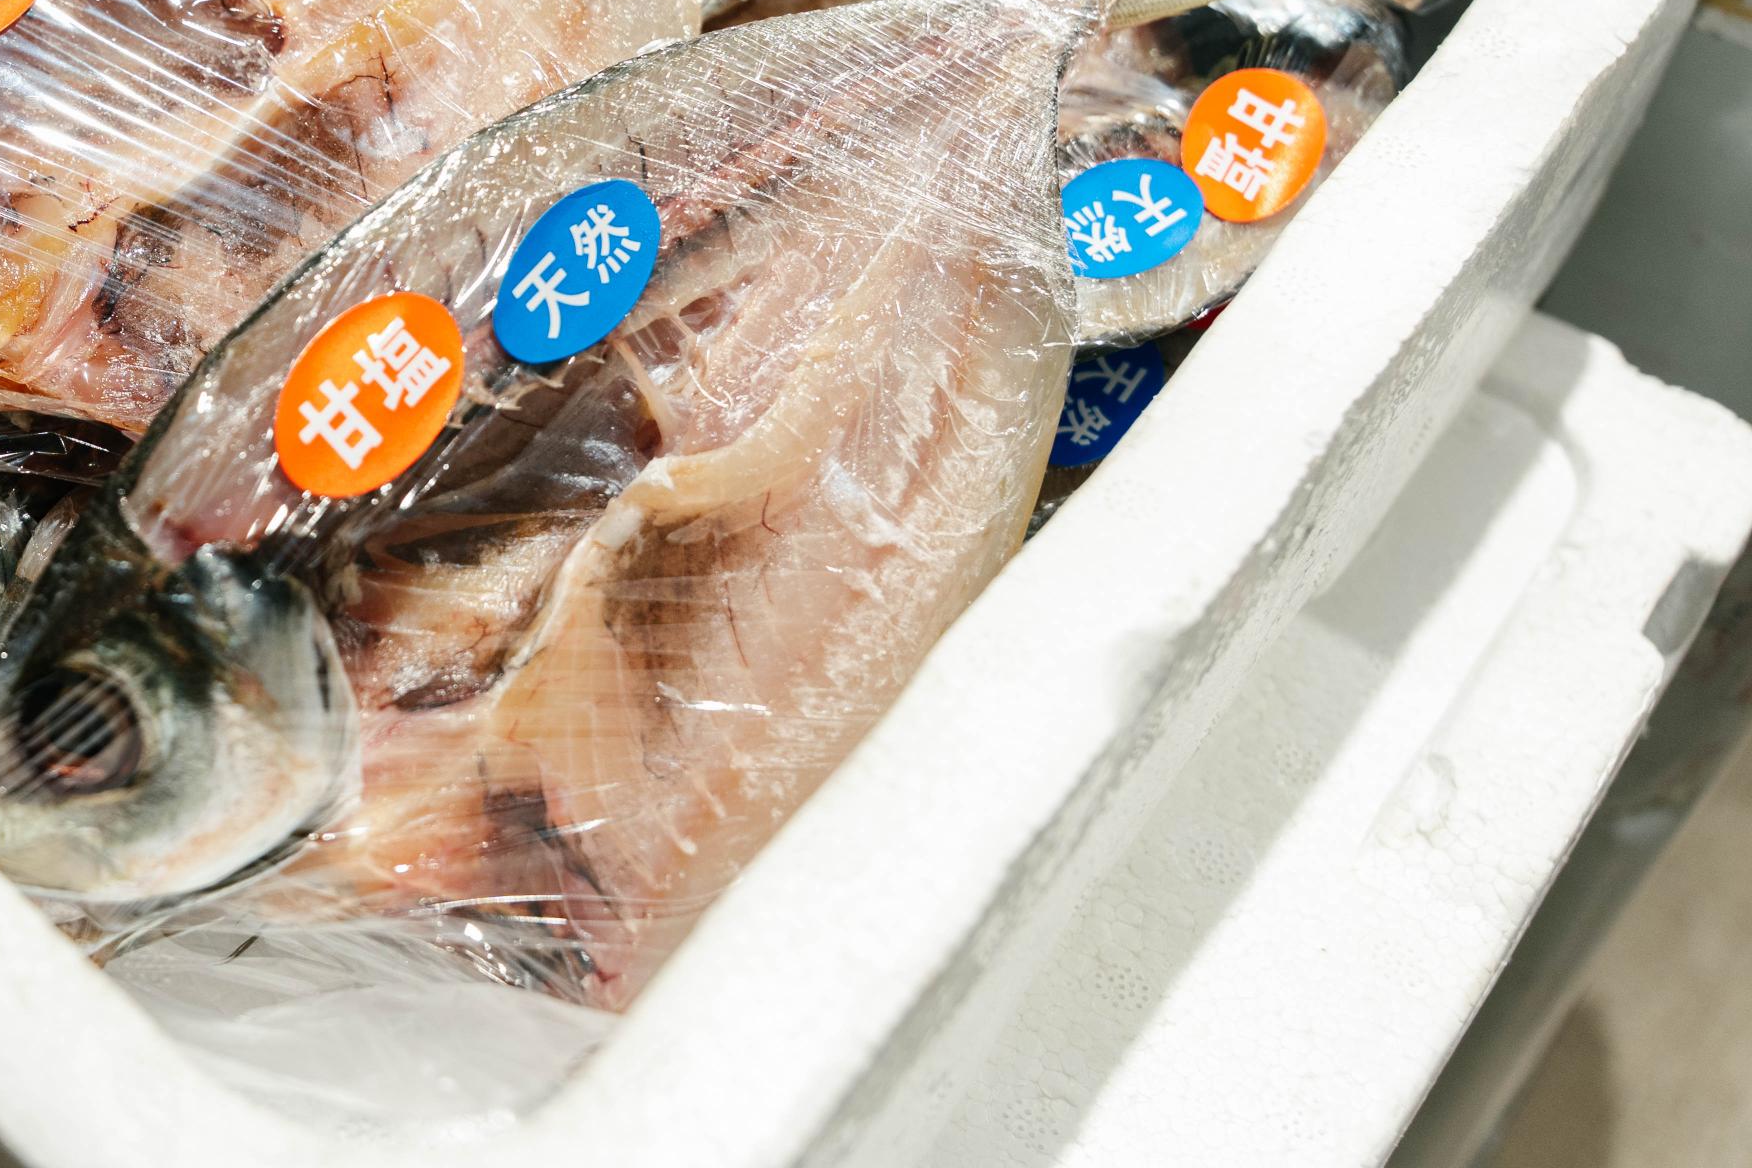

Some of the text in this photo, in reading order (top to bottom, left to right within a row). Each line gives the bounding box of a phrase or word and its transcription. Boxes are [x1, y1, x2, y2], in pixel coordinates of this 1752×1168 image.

[1195, 88, 1305, 203] 甘塩
[512, 203, 642, 339] 天然
[1065, 173, 1188, 263] 天然
[298, 316, 451, 471] 甘塩
